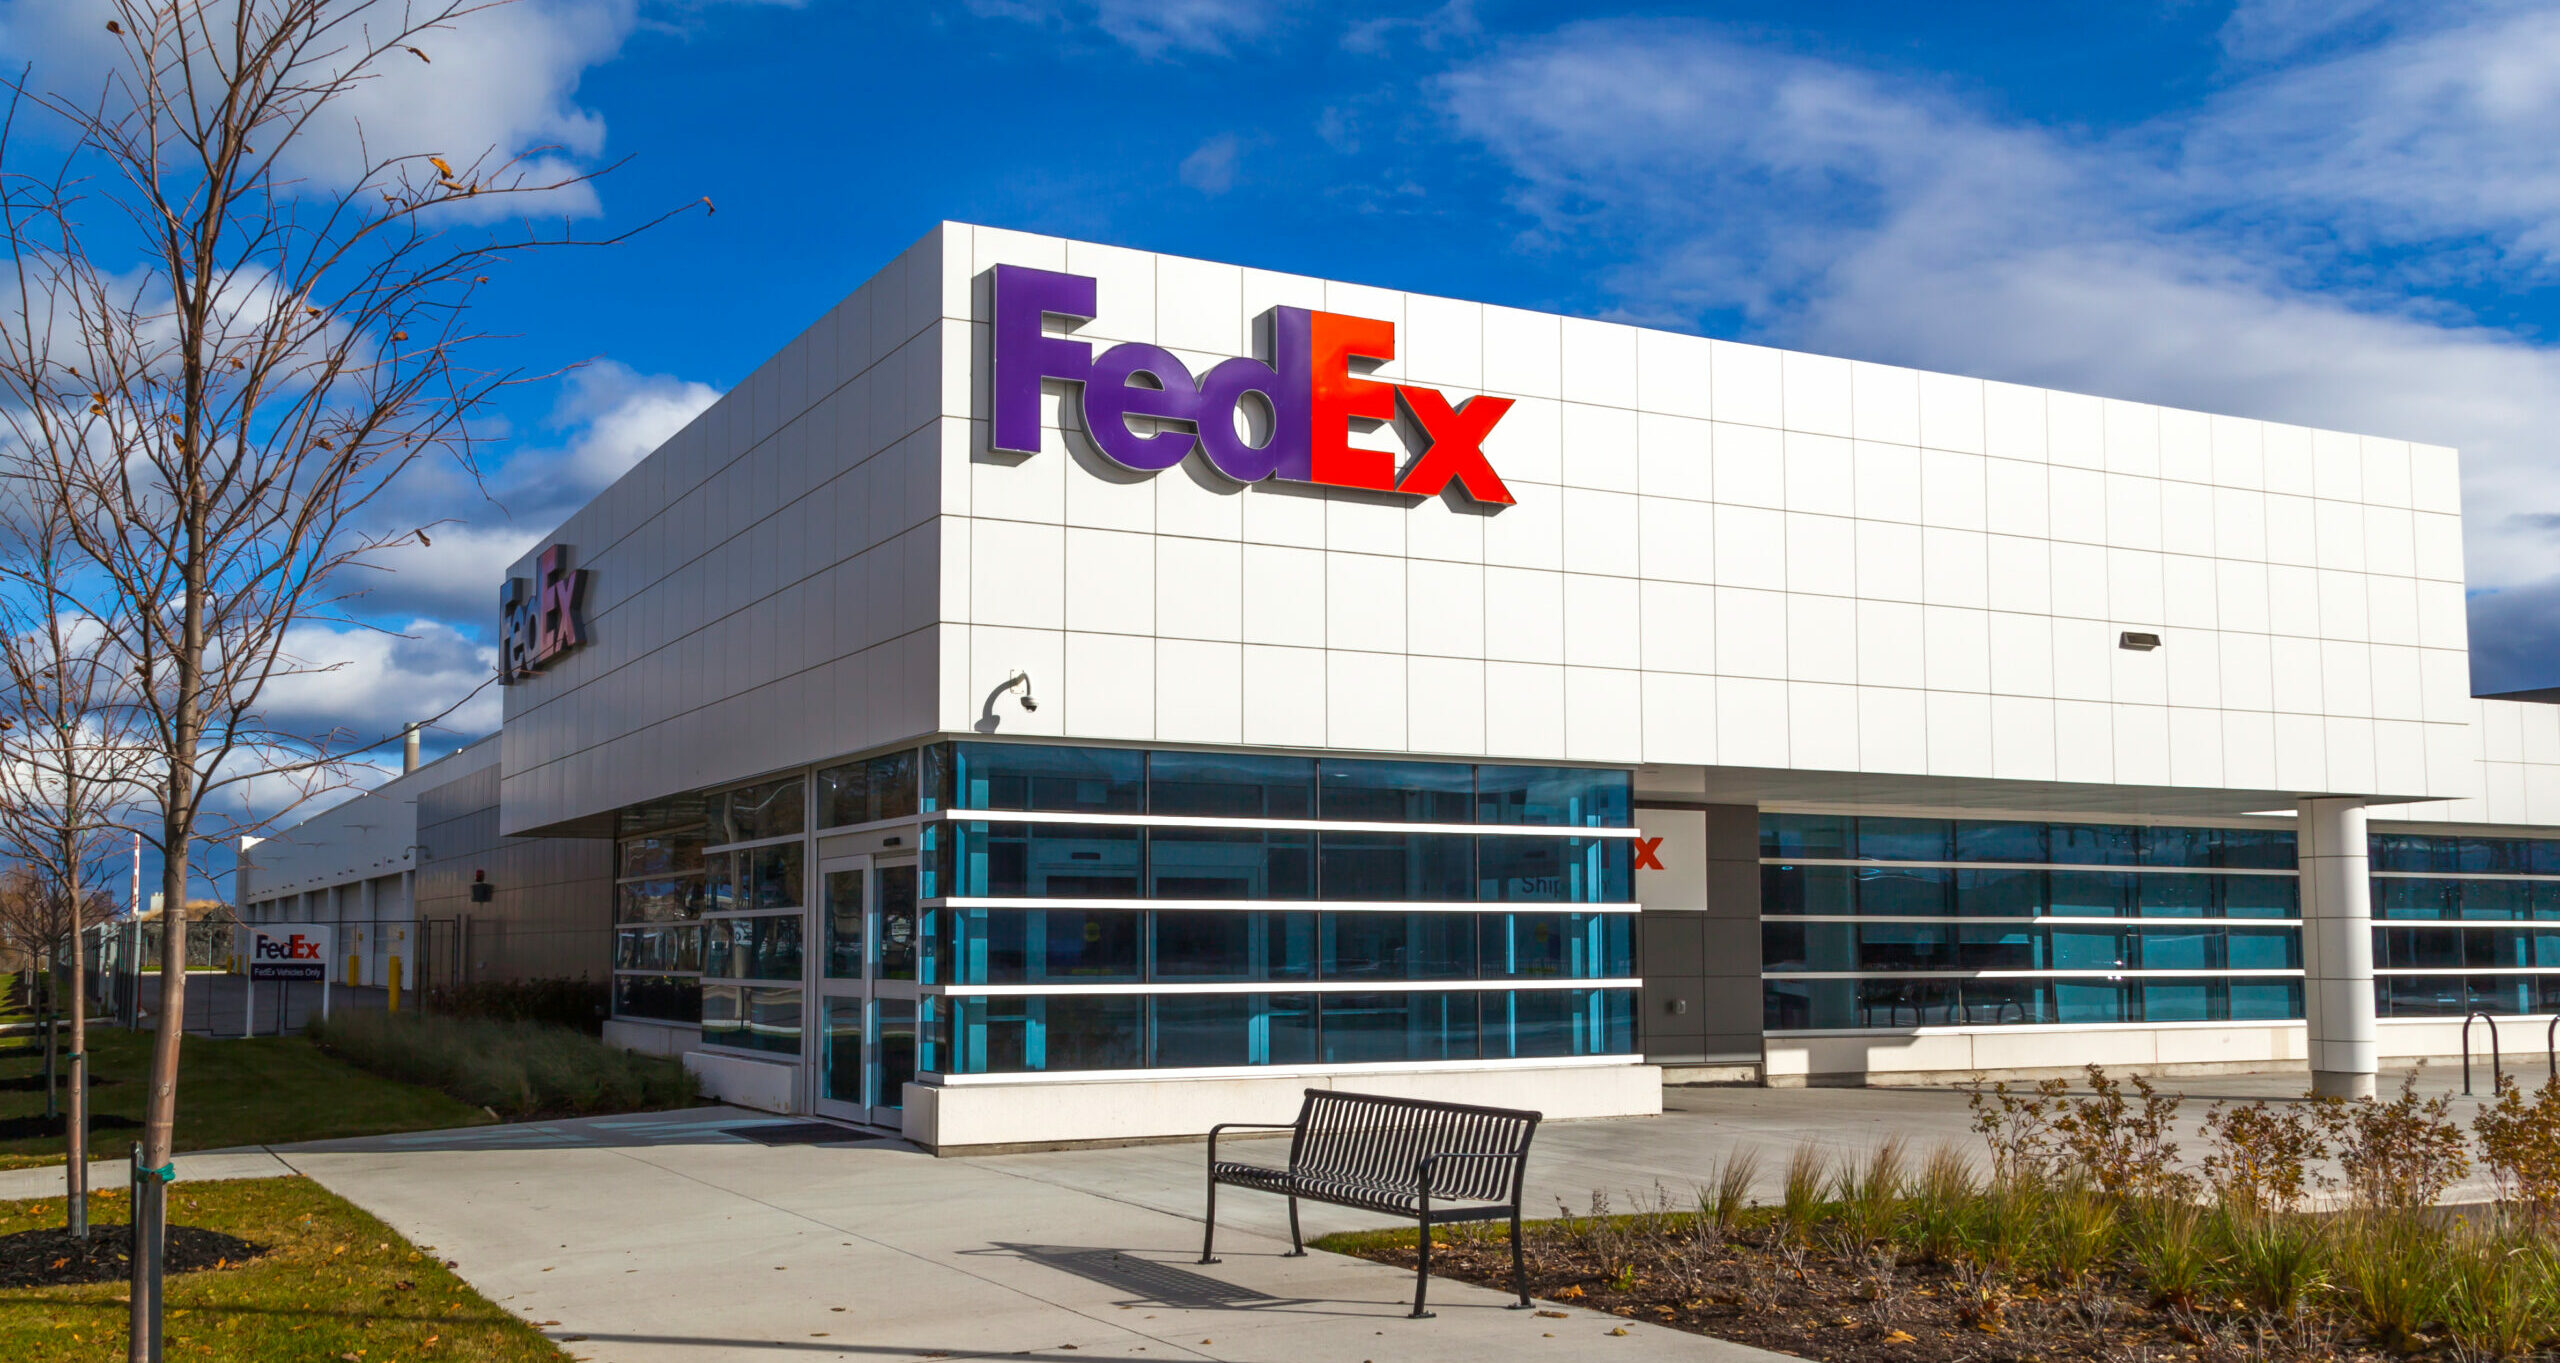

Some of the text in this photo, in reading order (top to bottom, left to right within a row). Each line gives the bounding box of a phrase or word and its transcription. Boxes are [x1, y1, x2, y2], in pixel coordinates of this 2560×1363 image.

[993, 263, 1516, 505] FedEx
[498, 544, 588, 685] FedEx
[254, 967, 275, 976] FedEx
[305, 967, 321, 978] Only
[256, 934, 320, 960] FedEx
